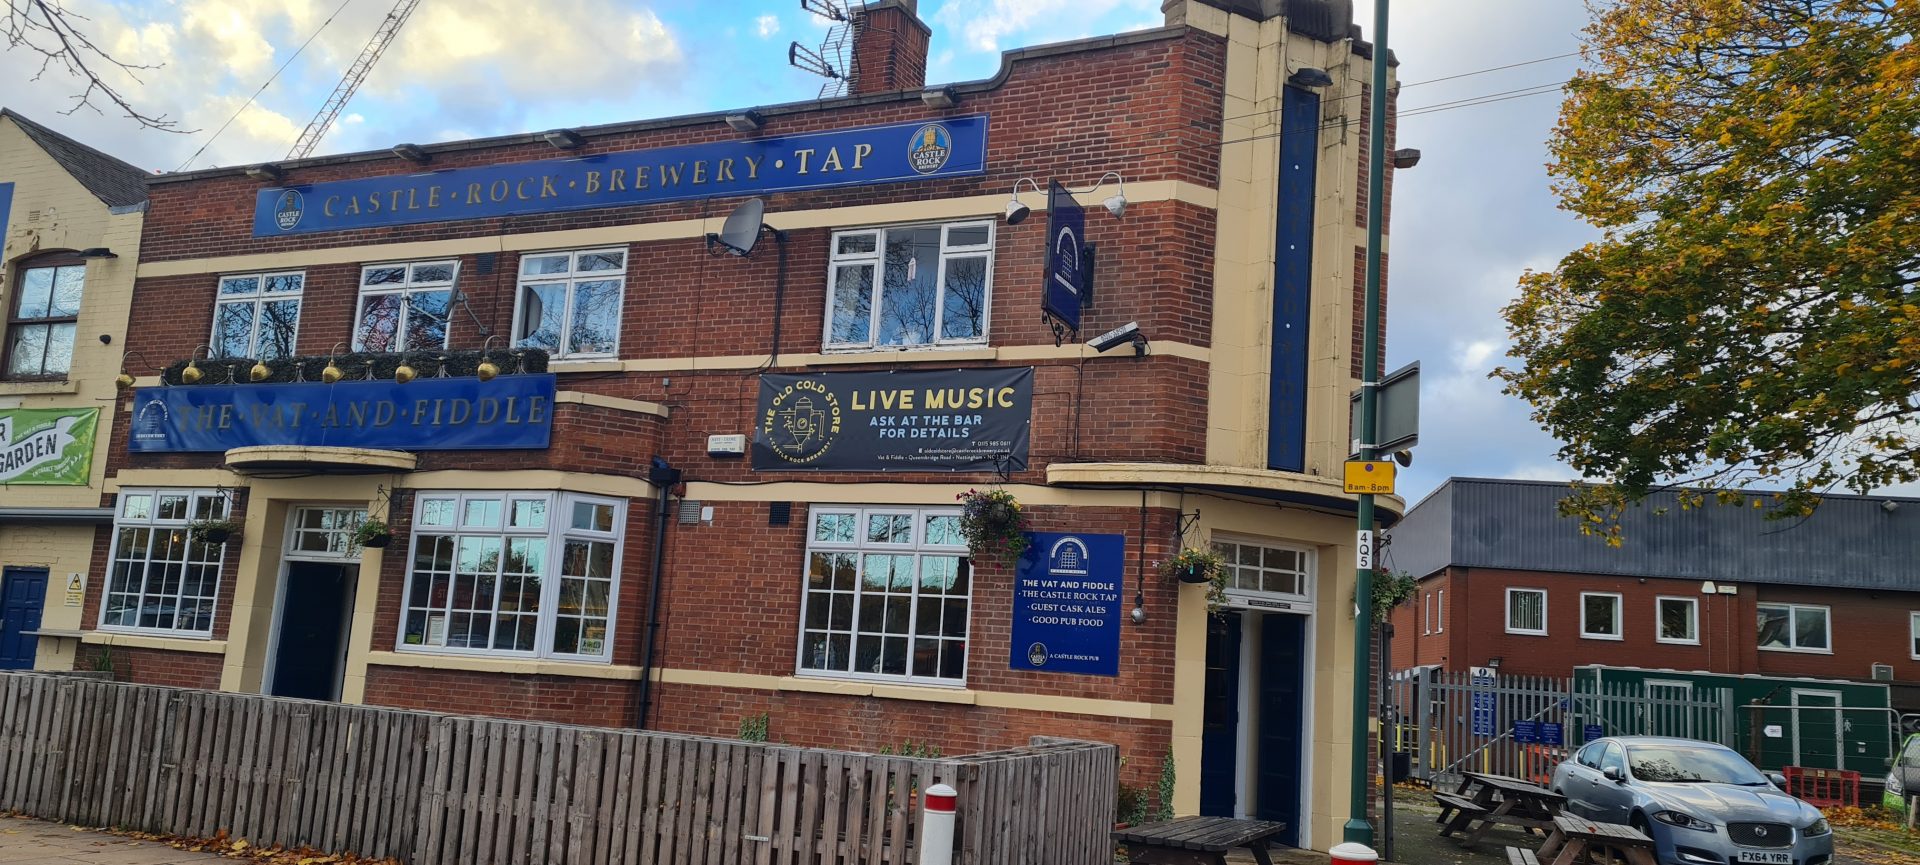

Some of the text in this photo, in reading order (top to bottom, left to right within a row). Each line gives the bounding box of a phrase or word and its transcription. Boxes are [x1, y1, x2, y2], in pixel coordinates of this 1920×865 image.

[913, 150, 945, 160] CASTLE
[917, 157, 941, 166] ROCK
[324, 143, 874, 217] CASTLE ROCK BREWERY TAP
[852, 387, 1015, 410] LIVE MUSIC
[764, 380, 840, 434] THE OLD COLD STORE
[178, 405, 233, 432] THE
[251, 402, 307, 428] VAT
[320, 401, 396, 427] AND
[411, 396, 546, 425] FIDDLE
[870, 415, 982, 426] ASK AT THE BAR
[880, 428, 970, 438] FOR DETAILS
[0, 434, 57, 473] GARDEN
[771, 441, 788, 460] CASTLE
[806, 441, 830, 462] BREWERY
[1082, 582, 1115, 590] FIDDLE
[1040, 591, 1072, 599] CASTLE
[1073, 592, 1098, 600] ROCK
[1031, 603, 1058, 612] GUEST
[1060, 604, 1083, 613] CASK
[1032, 616, 1059, 624] GOOD
[1078, 618, 1104, 627] FOOD
[1742, 852, 1788, 862] FX64 YRR
